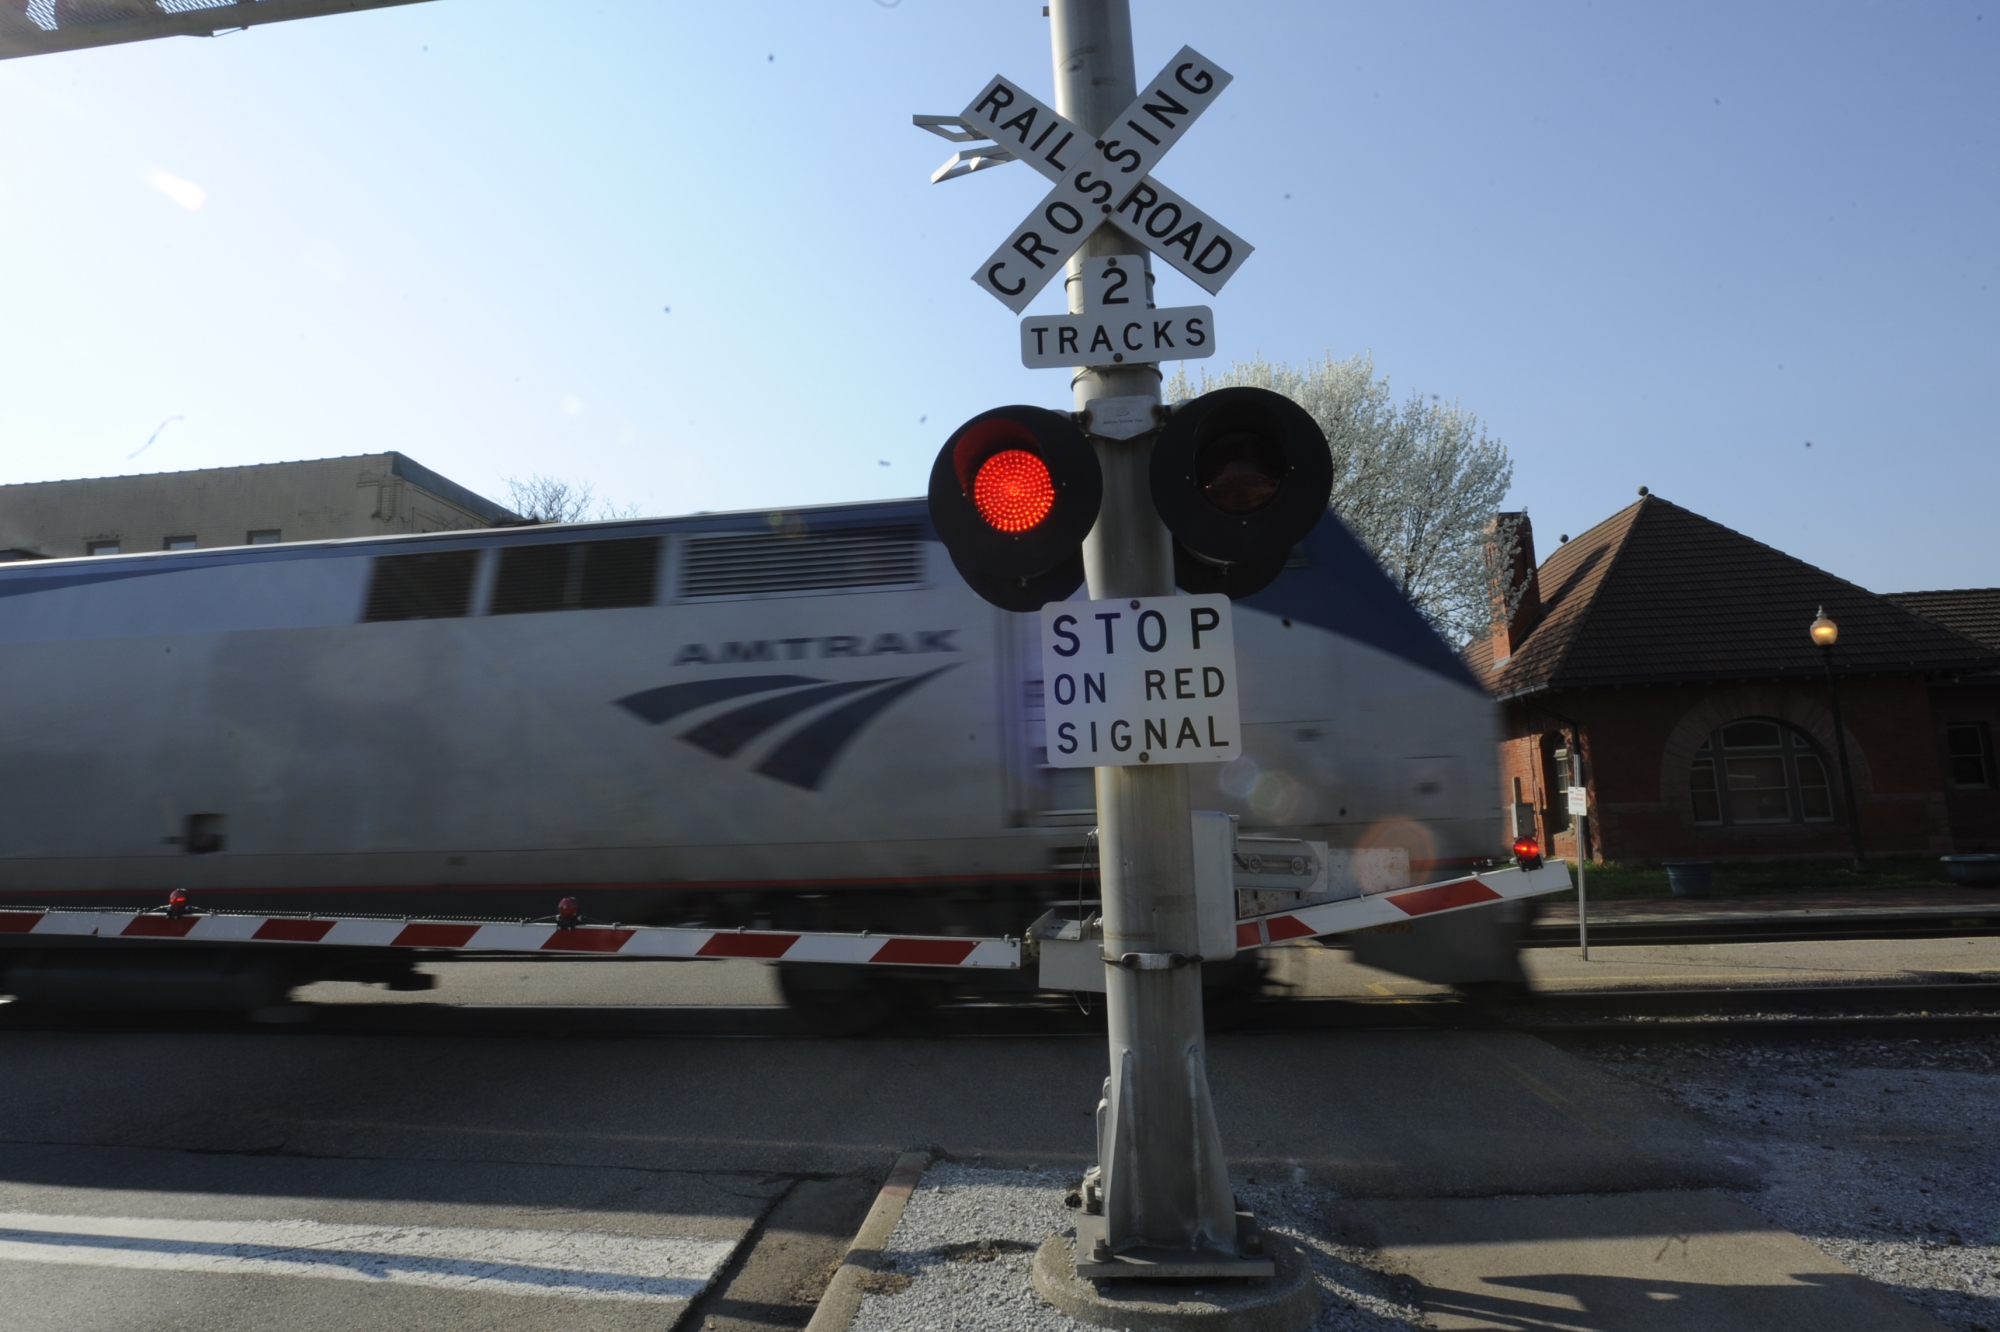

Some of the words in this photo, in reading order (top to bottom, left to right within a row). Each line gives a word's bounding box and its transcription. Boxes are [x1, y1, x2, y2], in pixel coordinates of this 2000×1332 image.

[974, 82, 1076, 173] RAIL
[1116, 181, 1233, 275] ROAD
[987, 62, 1214, 297] CROSSING
[1101, 267, 1130, 306] 2
[1030, 317, 1206, 356] TRACKS
[671, 629, 961, 666] AMTRAK
[1052, 606, 1220, 658] STOP
[1053, 672, 1107, 706] ON
[1144, 666, 1225, 701] RED
[1057, 715, 1230, 755] SIGNAL
